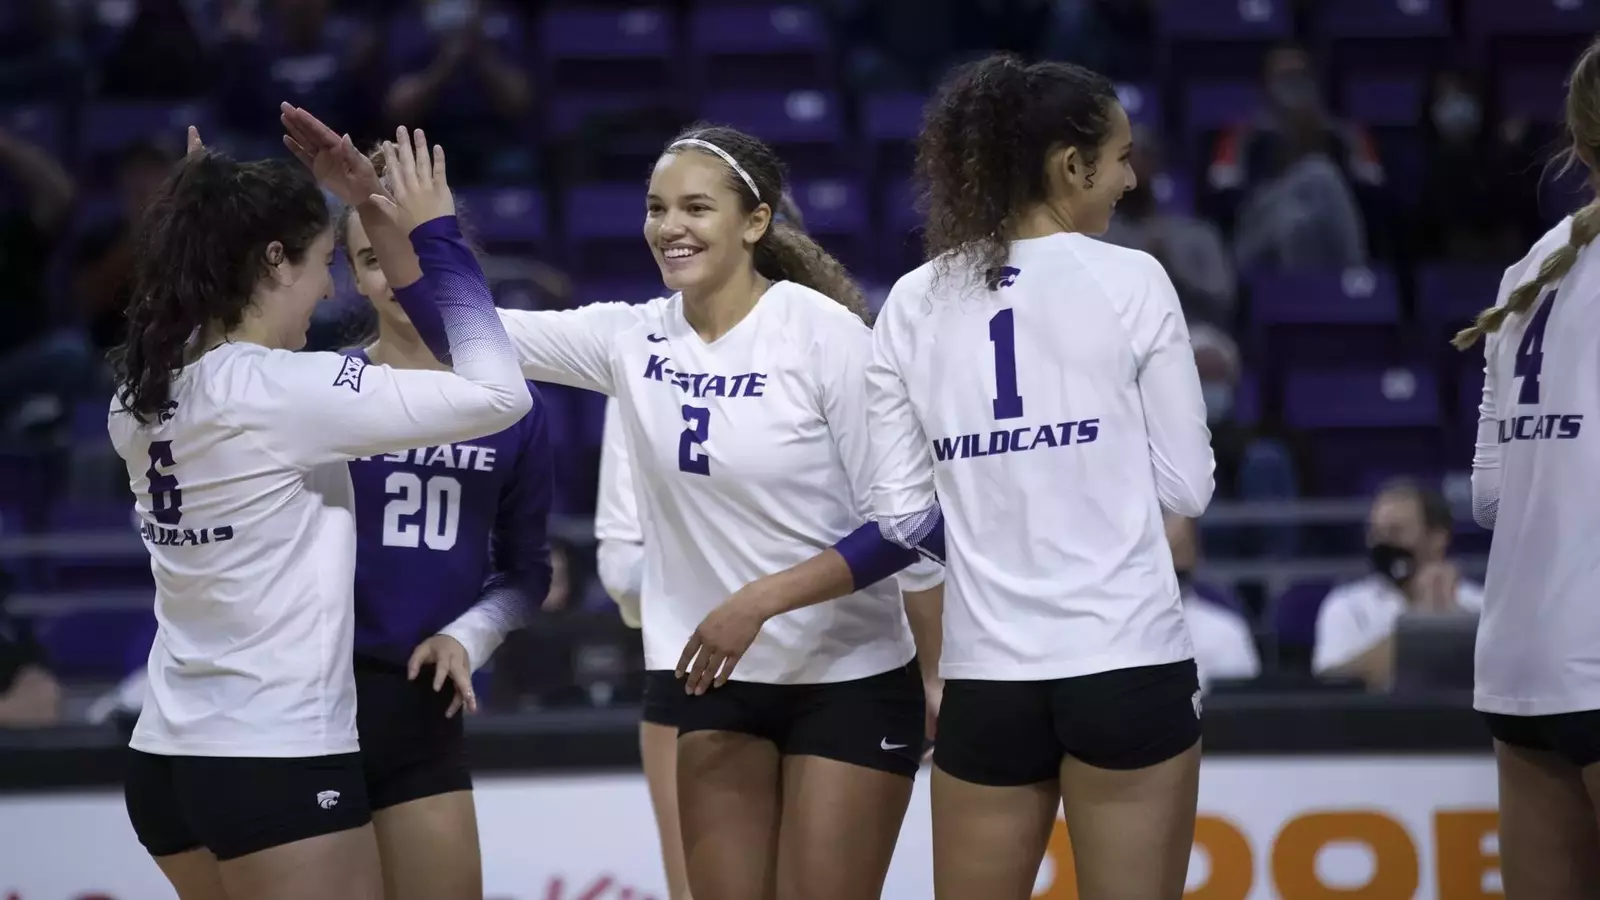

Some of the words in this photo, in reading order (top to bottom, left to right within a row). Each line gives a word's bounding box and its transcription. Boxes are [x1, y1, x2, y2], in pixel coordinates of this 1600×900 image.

[643, 354, 768, 397] K-STATE
[989, 308, 1023, 420] 1
[1514, 288, 1558, 404] 4
[678, 404, 711, 476] 2
[932, 418, 1100, 461] WILDCATS
[146, 440, 182, 525] 6
[382, 471, 462, 551] 20
